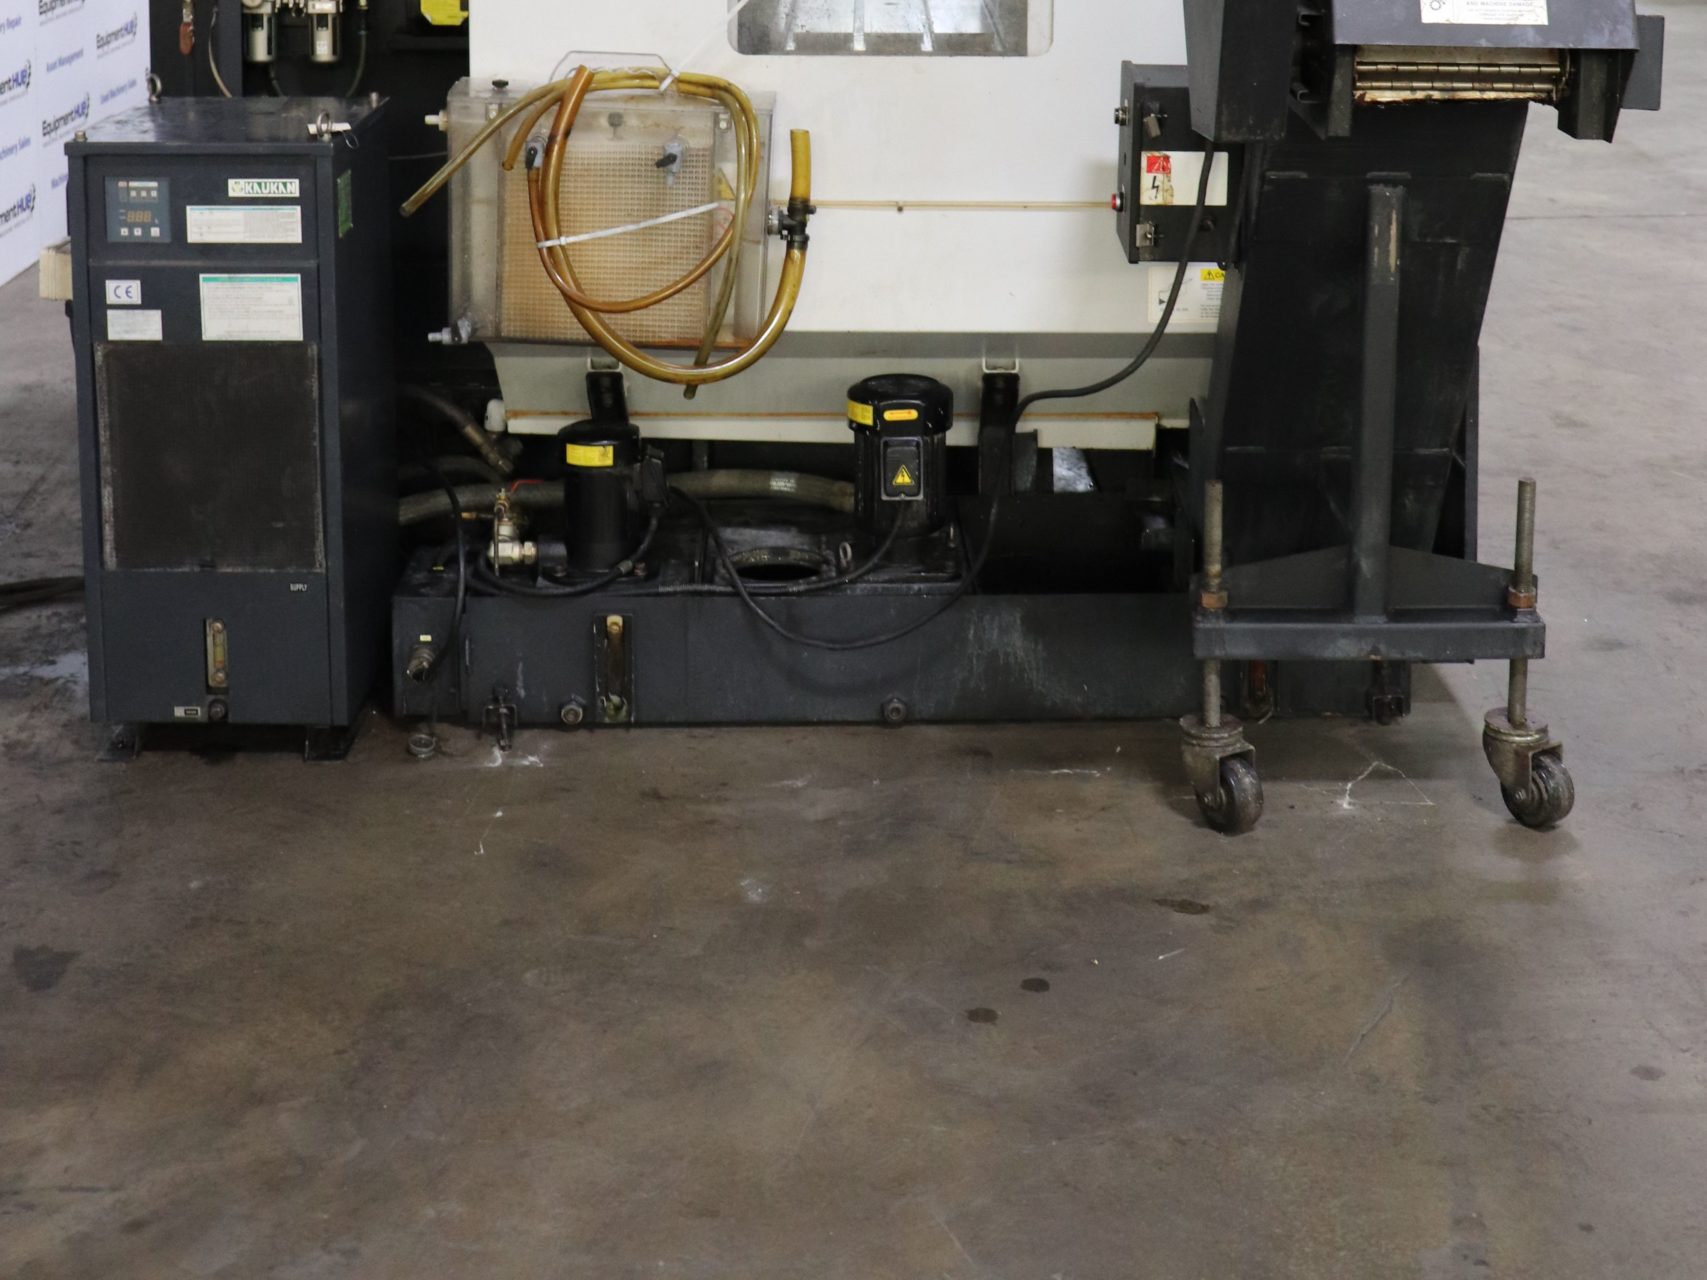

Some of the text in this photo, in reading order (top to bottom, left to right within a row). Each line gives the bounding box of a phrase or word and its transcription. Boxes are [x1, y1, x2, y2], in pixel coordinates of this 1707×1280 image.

[96, 19, 134, 50] EquipmentHUB
[42, 100, 87, 138] EquipmentHUB
[18, 136, 31, 151] Sales
[244, 181, 297, 195] KAUKAN
